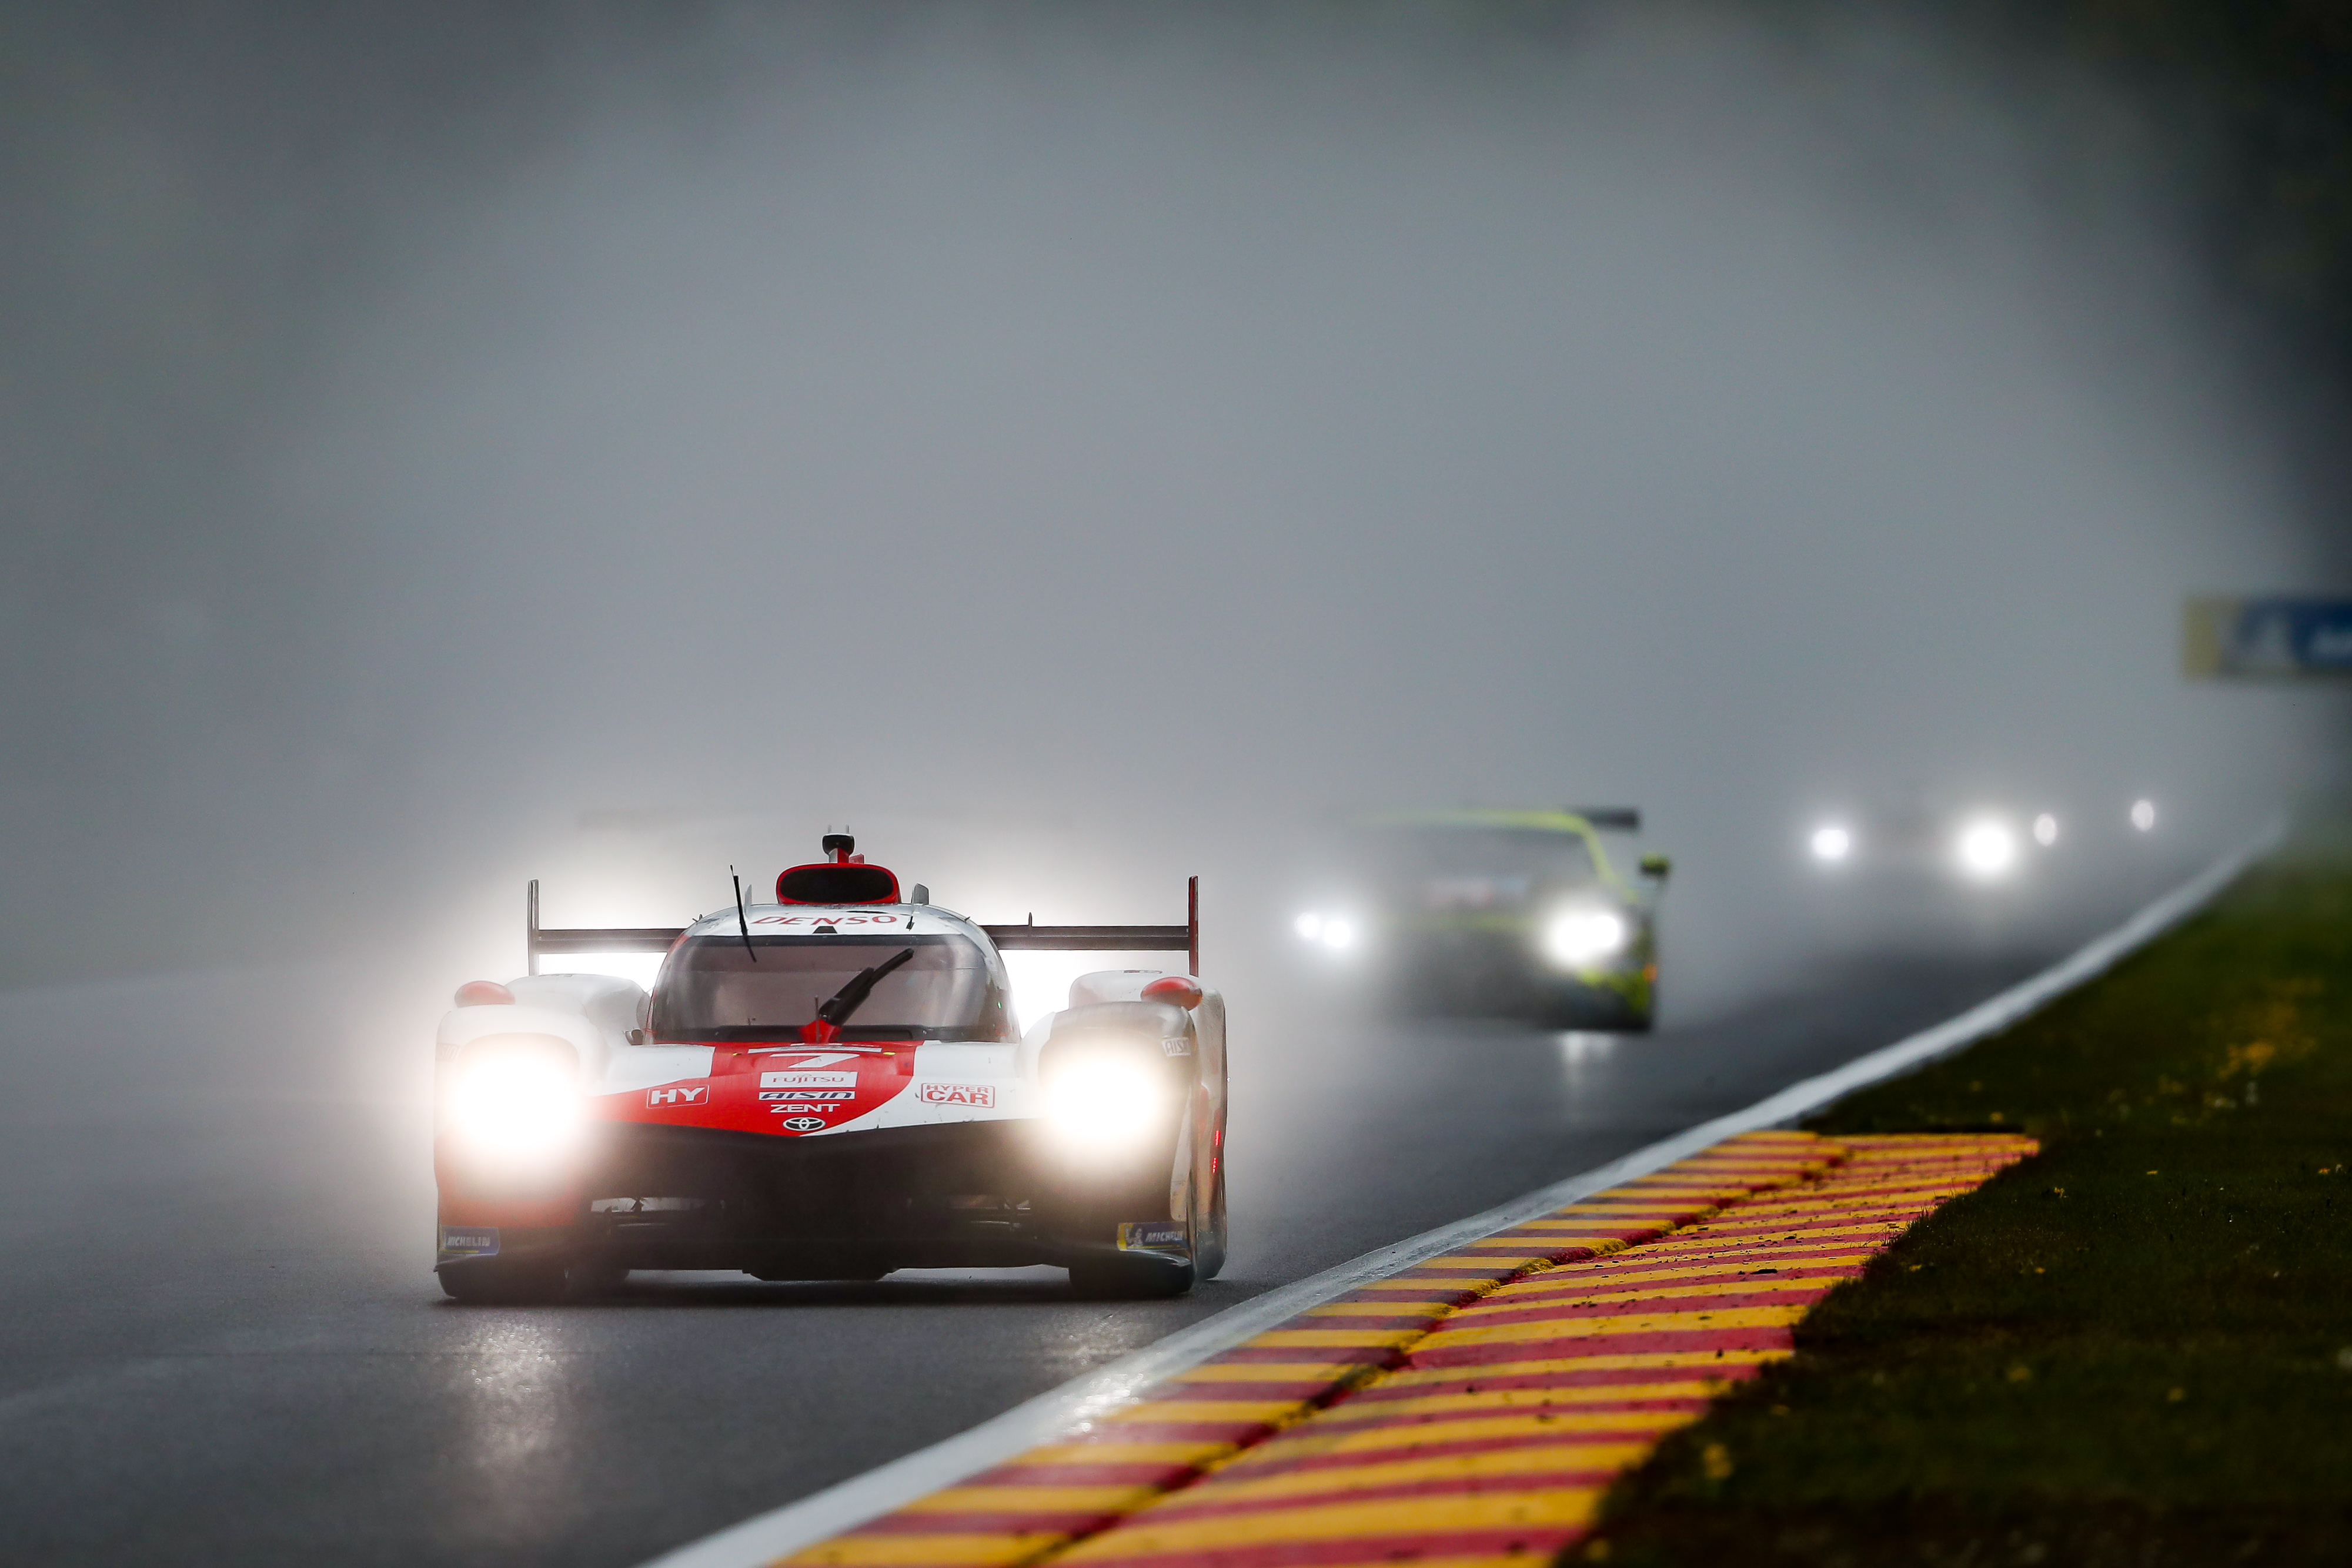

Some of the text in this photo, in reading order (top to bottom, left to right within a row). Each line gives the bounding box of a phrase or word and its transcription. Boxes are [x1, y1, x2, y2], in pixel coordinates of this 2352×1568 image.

[750, 915, 897, 925] DENSO
[769, 1053, 860, 1068] 7
[650, 1086, 706, 1105] HY
[926, 1085, 989, 1094] HYPER
[927, 1091, 989, 1105] CAR
[770, 1103, 841, 1113] ZENT
